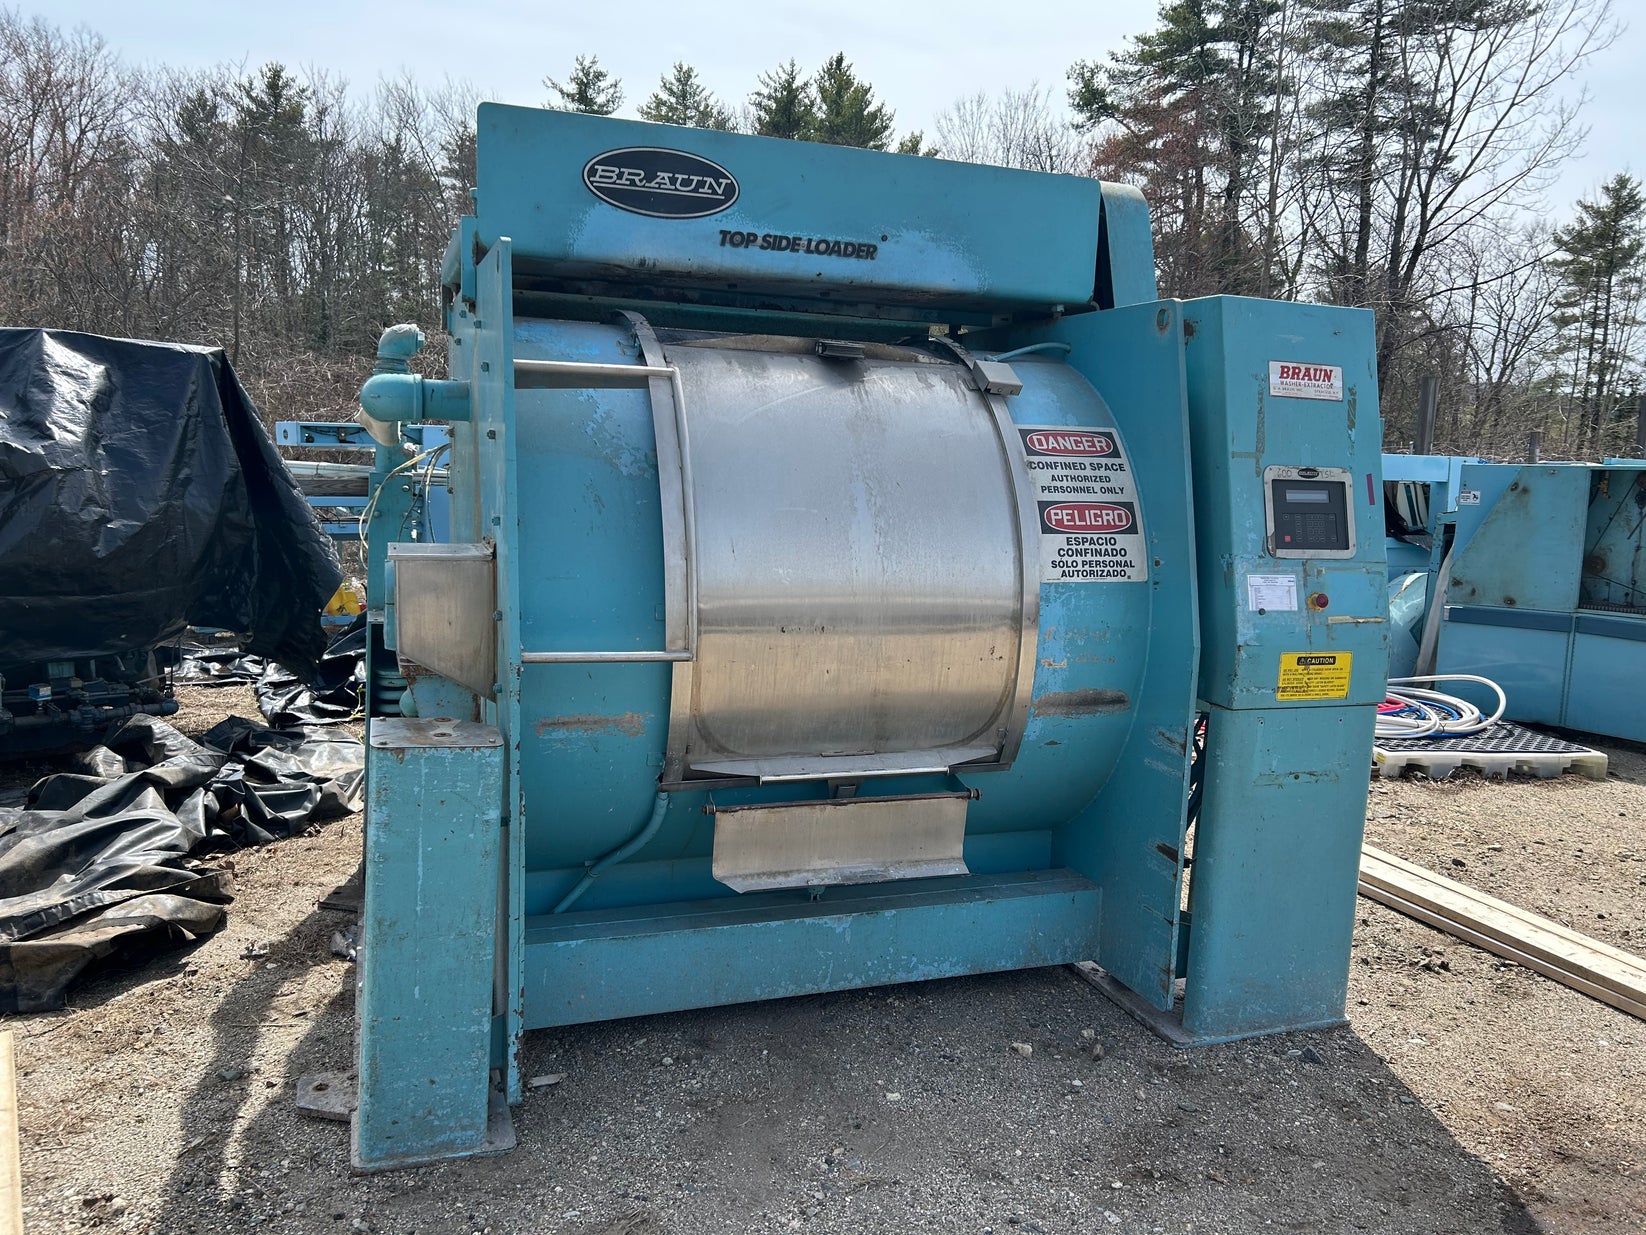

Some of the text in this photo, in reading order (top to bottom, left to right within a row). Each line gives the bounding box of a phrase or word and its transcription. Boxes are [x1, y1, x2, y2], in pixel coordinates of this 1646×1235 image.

[589, 165, 731, 195] BRAUN
[719, 229, 758, 248] TOP
[1279, 365, 1333, 383] BRAUN
[1032, 435, 1108, 451] DANGER
[1030, 461, 1126, 472] CONFINED SPACE
[1051, 475, 1111, 483] AUTHORIZED
[1041, 485, 1125, 495] PERSONNEL ONLY
[1050, 509, 1127, 526] PELIGRO
[1066, 537, 1117, 546] ESPACIO
[1057, 548, 1127, 558] CONFINADO
[1051, 558, 1135, 569] SÓLO PERSONAL
